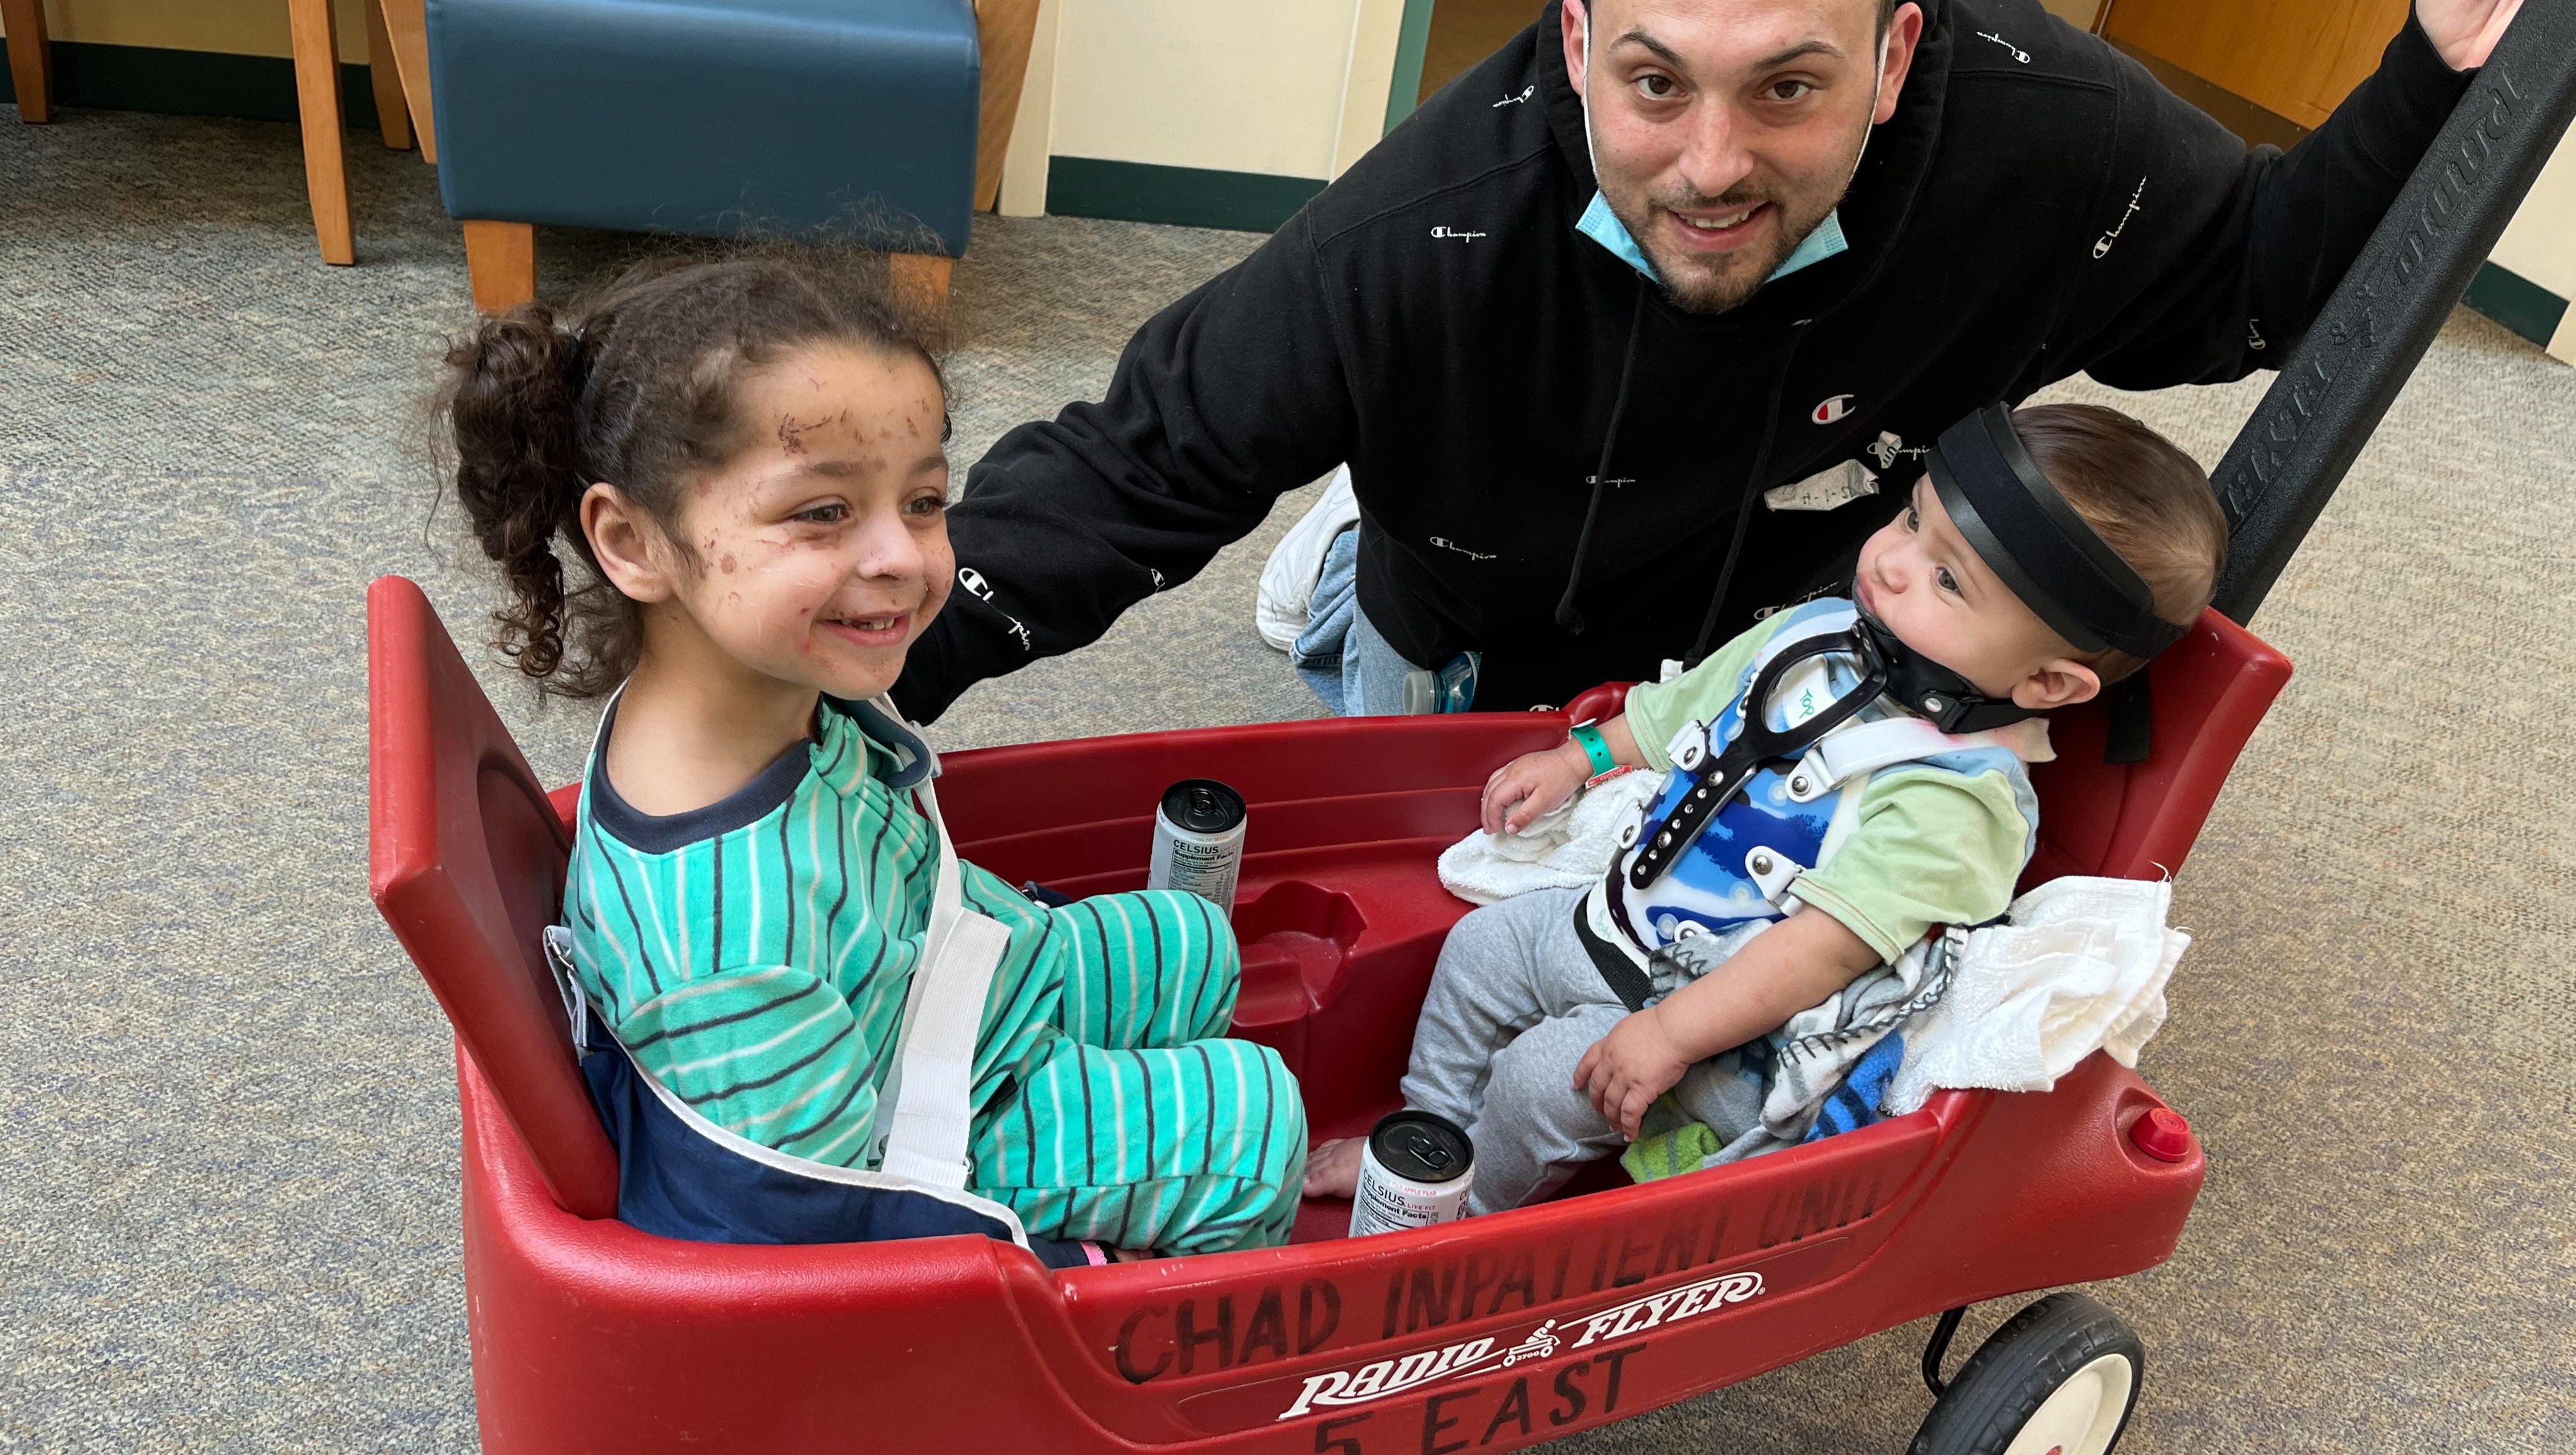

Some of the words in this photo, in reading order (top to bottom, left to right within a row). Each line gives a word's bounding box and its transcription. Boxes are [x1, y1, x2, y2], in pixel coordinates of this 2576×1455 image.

[1977, 31, 2030, 63] Champion
[2395, 63, 2531, 287] RADIO
[2092, 175, 2147, 259] Champion
[1430, 226, 1487, 243] Champion
[1430, 537, 1497, 560] Champion
[1799, 688, 1814, 719] TOP
[1173, 839, 1220, 854] CELSIUS
[1174, 849, 1215, 861] Supplement
[1216, 852, 1234, 861] Facts
[1363, 1169, 1405, 1206] CELSIUS
[1404, 1187, 1422, 1196] APPLE
[1402, 1209, 1427, 1219] Facts
[1116, 1278, 1342, 1384] CHAD
[1516, 1350, 1540, 1361] 2700
[1276, 1337, 1496, 1422] RADIO
[1422, 1342, 1647, 1455] EAST
